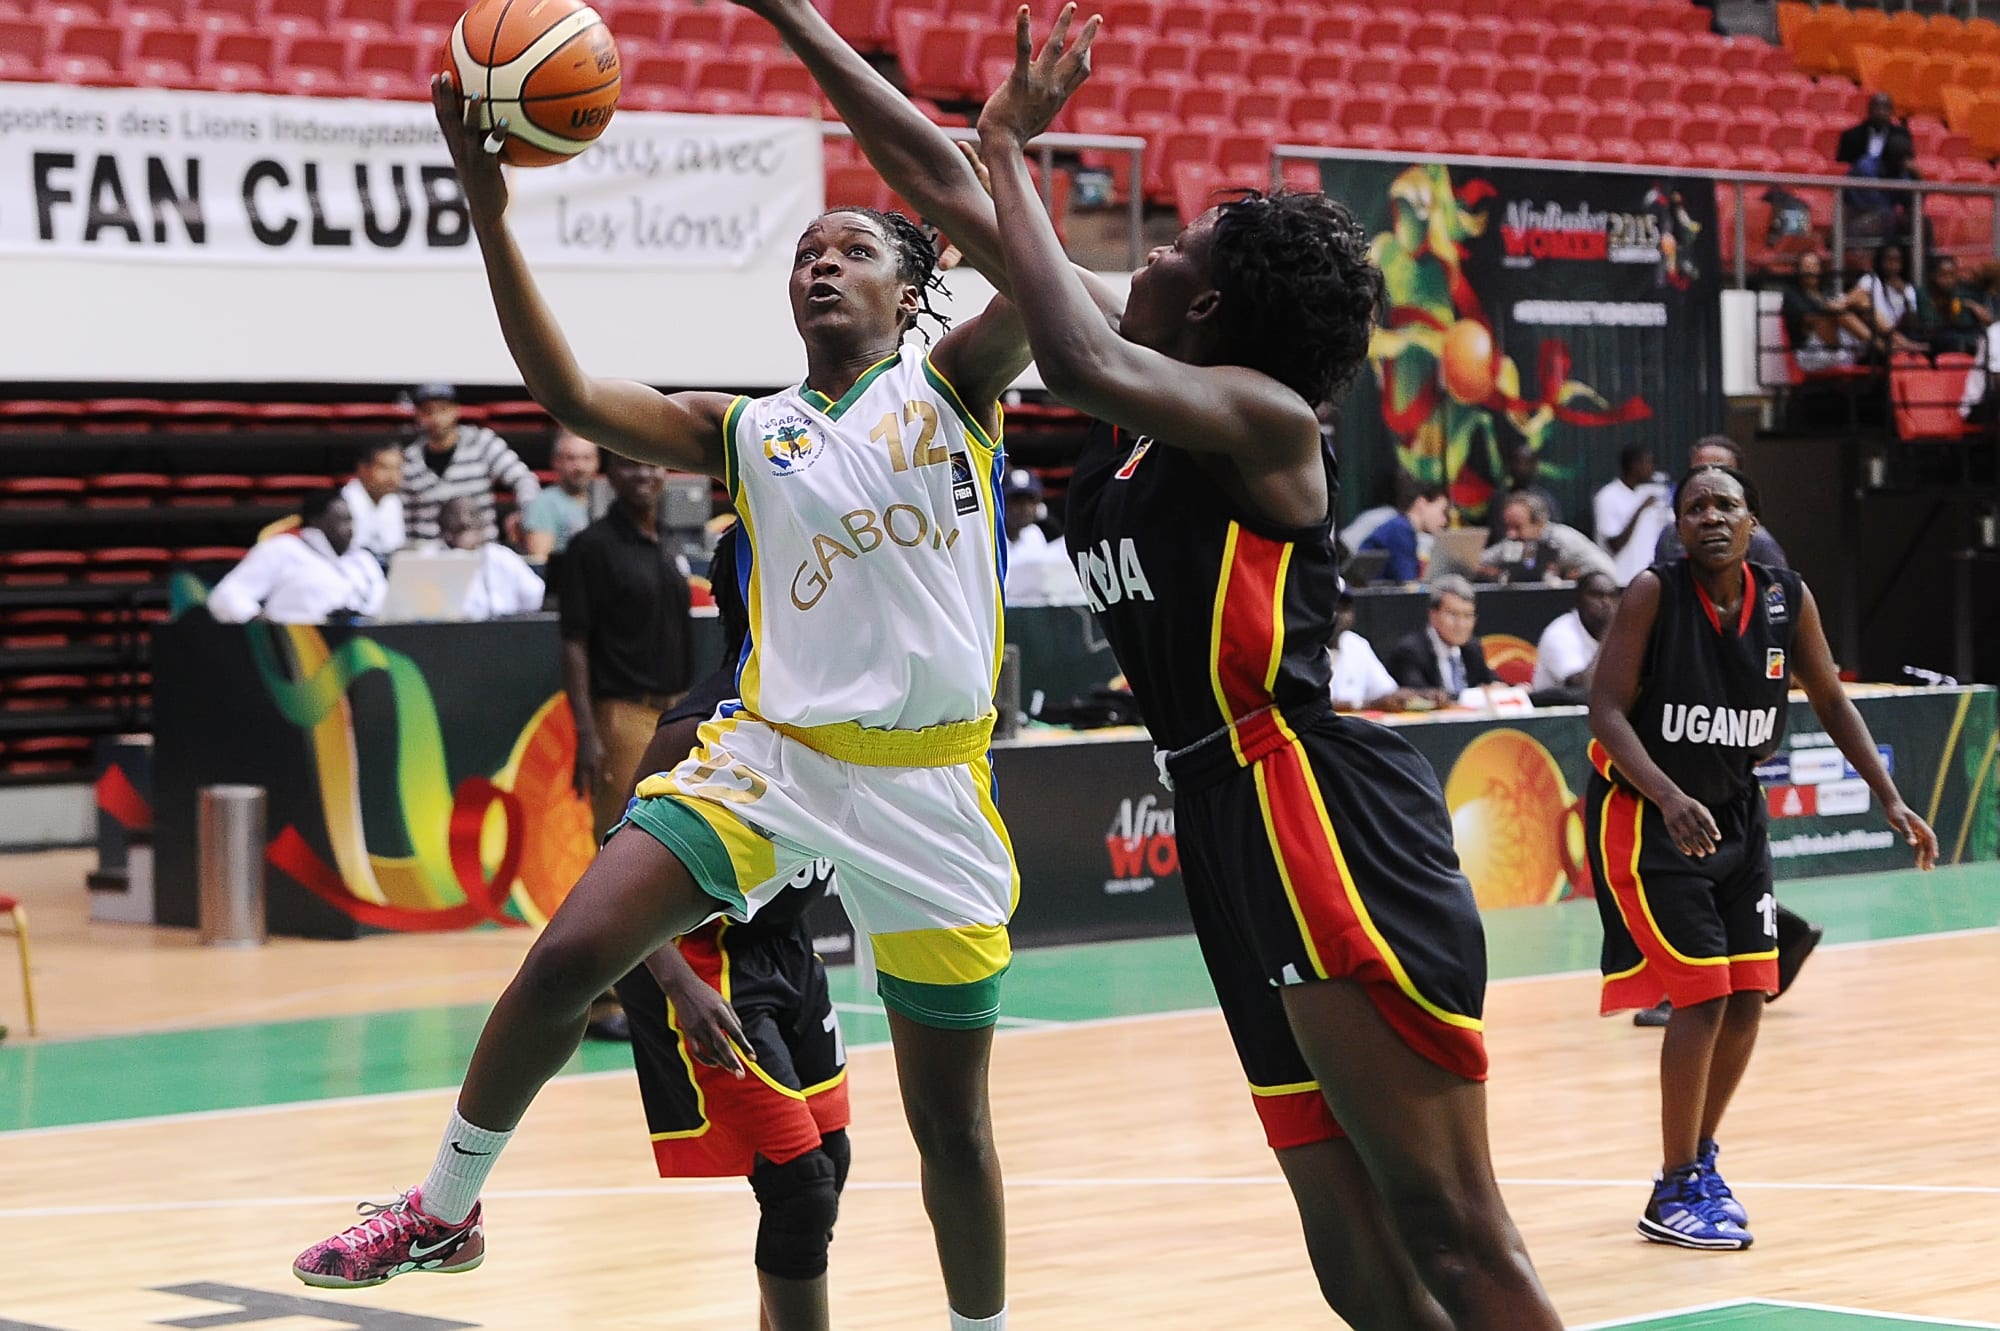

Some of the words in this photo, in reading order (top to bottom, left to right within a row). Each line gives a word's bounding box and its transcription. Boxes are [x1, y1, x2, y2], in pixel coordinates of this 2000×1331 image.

[120, 107, 168, 134] des
[183, 109, 256, 138] Lions
[272, 113, 446, 147] Indomptable
[675, 138, 786, 177] avec
[34, 152, 205, 244] FAN
[243, 160, 470, 248] CLUB
[556, 194, 619, 249] les
[869, 400, 950, 473] 12
